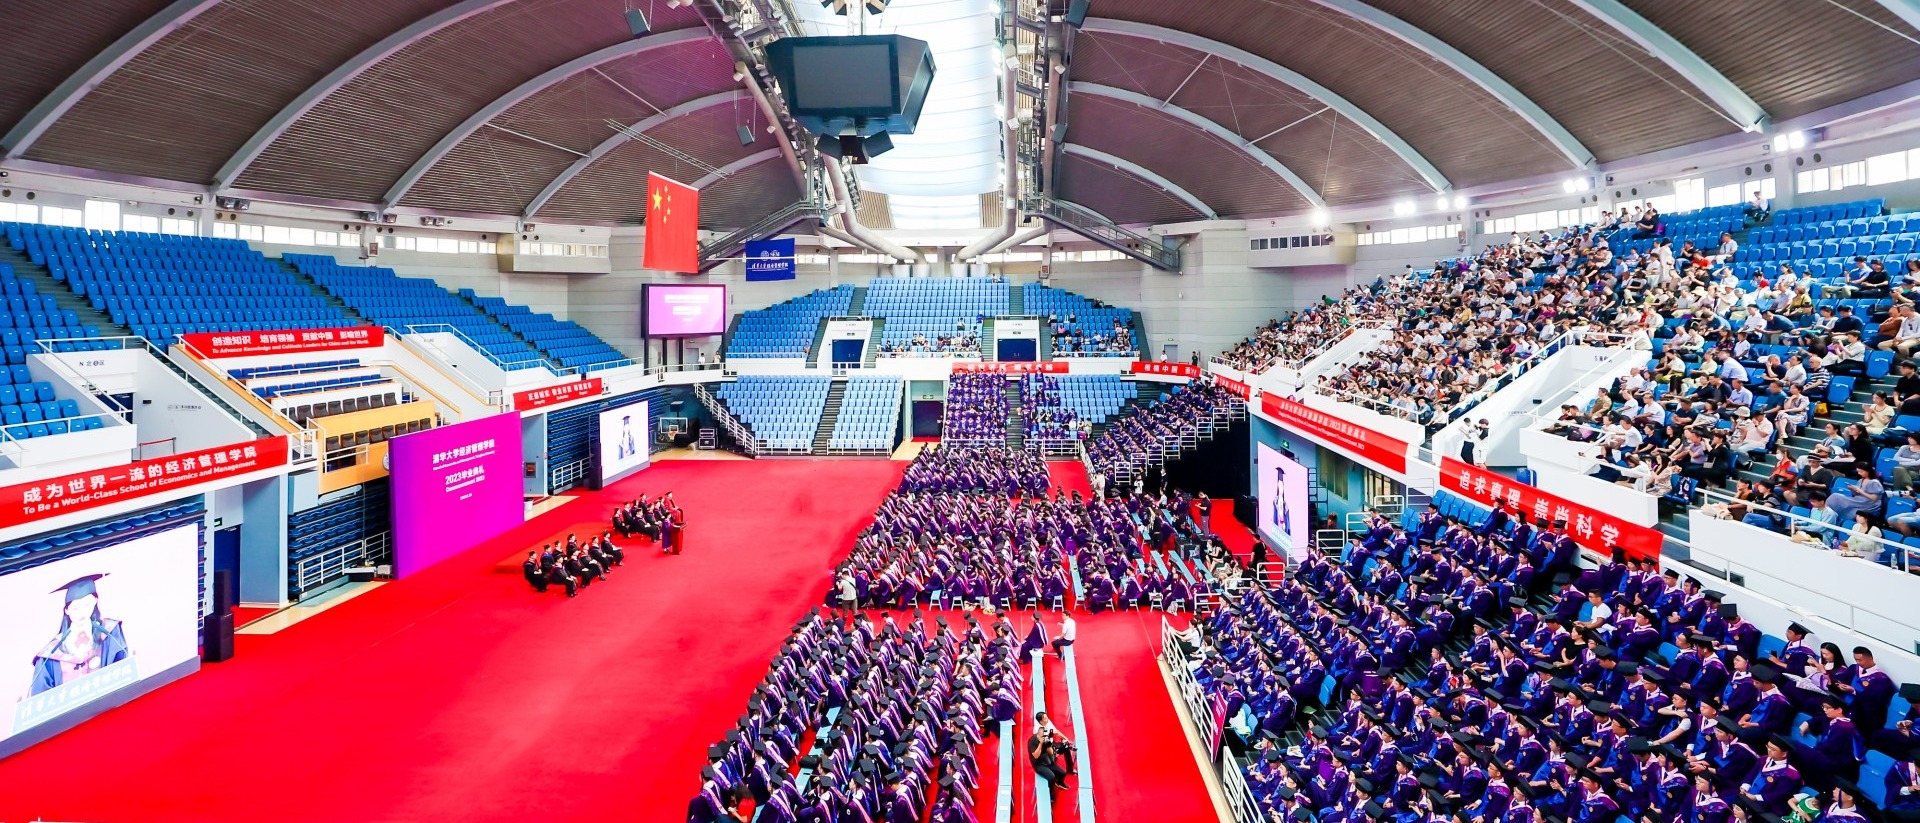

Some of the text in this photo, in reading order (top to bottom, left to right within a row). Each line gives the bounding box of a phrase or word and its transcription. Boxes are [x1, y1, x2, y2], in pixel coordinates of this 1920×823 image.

[23, 446, 257, 504] 成为世界一流的经济管理学院
[432, 439, 495, 464] 清华大学经济管理学院
[445, 465, 485, 485] 2023毕业典礼
[23, 506, 35, 515] To
[38, 502, 51, 511] Be
[62, 488, 118, 507] World-Class
[120, 483, 147, 493] School
[158, 472, 198, 486] Economics
[199, 468, 212, 476] and
[214, 460, 257, 474] Management.
[1459, 469, 1620, 547] 追求真理 崇尚科学
